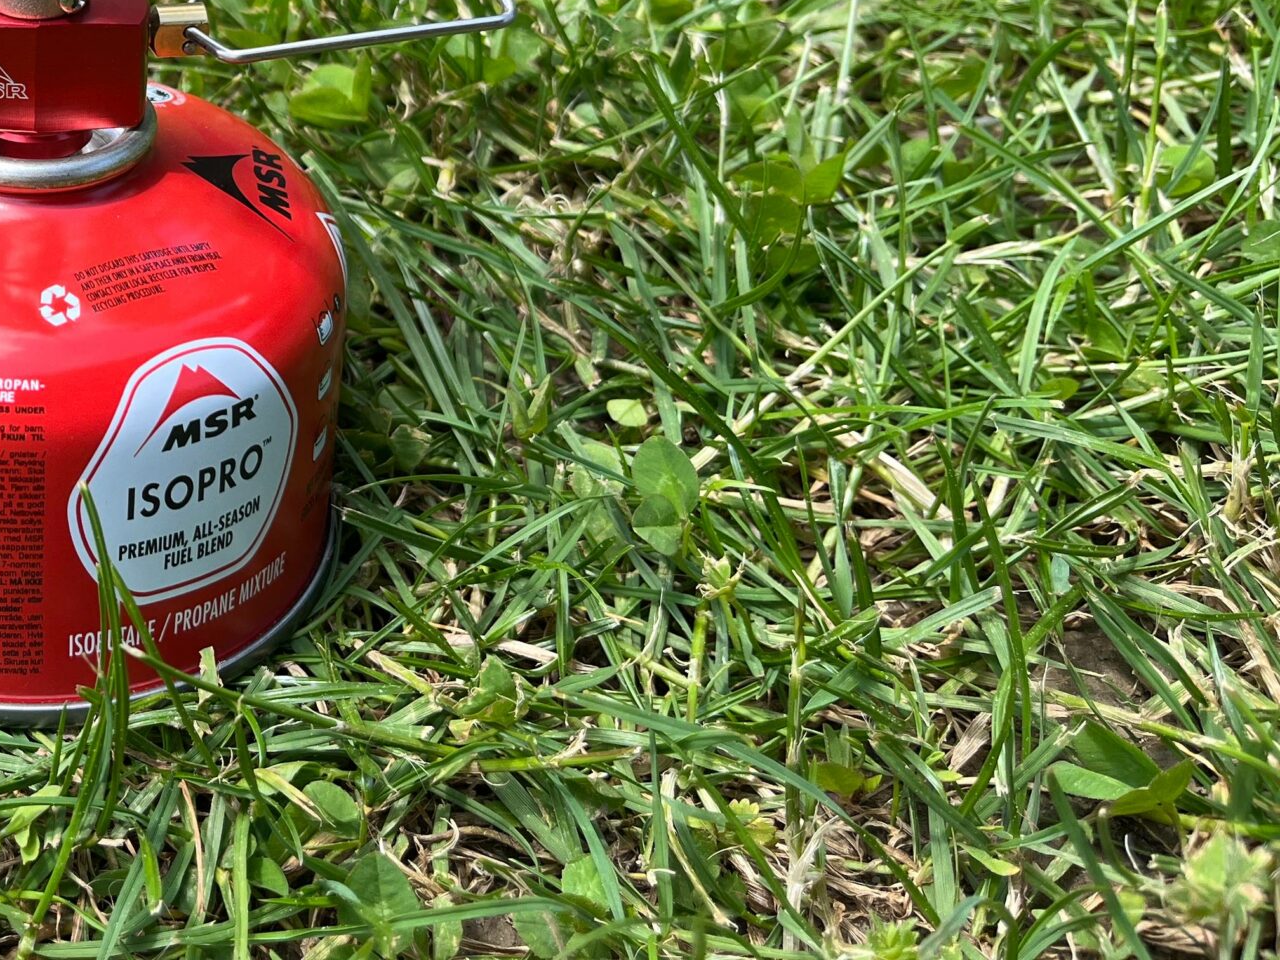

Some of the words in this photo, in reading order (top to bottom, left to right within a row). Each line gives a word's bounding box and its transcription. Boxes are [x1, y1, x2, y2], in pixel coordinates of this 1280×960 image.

[251, 149, 293, 221] MSR
[74, 272, 86, 282] DO
[86, 267, 99, 278] NOT
[98, 259, 125, 275] DISCARD
[124, 255, 140, 266] THIS
[138, 248, 173, 262] CARTRIDGE
[81, 280, 95, 292] AND
[96, 275, 113, 287] THEN
[113, 269, 130, 282] ONLY
[140, 262, 154, 274] SAFE
[154, 257, 173, 270] PLACE
[86, 289, 113, 303] CONTACT
[113, 281, 130, 295] YOUR
[130, 276, 150, 289] LOCAL
[149, 269, 179, 283] RECYCLER
[179, 266, 193, 278] FOR
[92, 295, 128, 313] RECYCLING
[9, 424, 20, 432] for
[15, 406, 45, 414] UNDER
[161, 396, 257, 453] MSR
[118, 530, 189, 562] PREMIUM,
[193, 495, 261, 543] ALL-SEASON
[163, 546, 193, 570] FUEL
[197, 530, 234, 560] BLEND
[174, 588, 236, 635] PROPANE
[238, 551, 287, 605] MIXTURE
